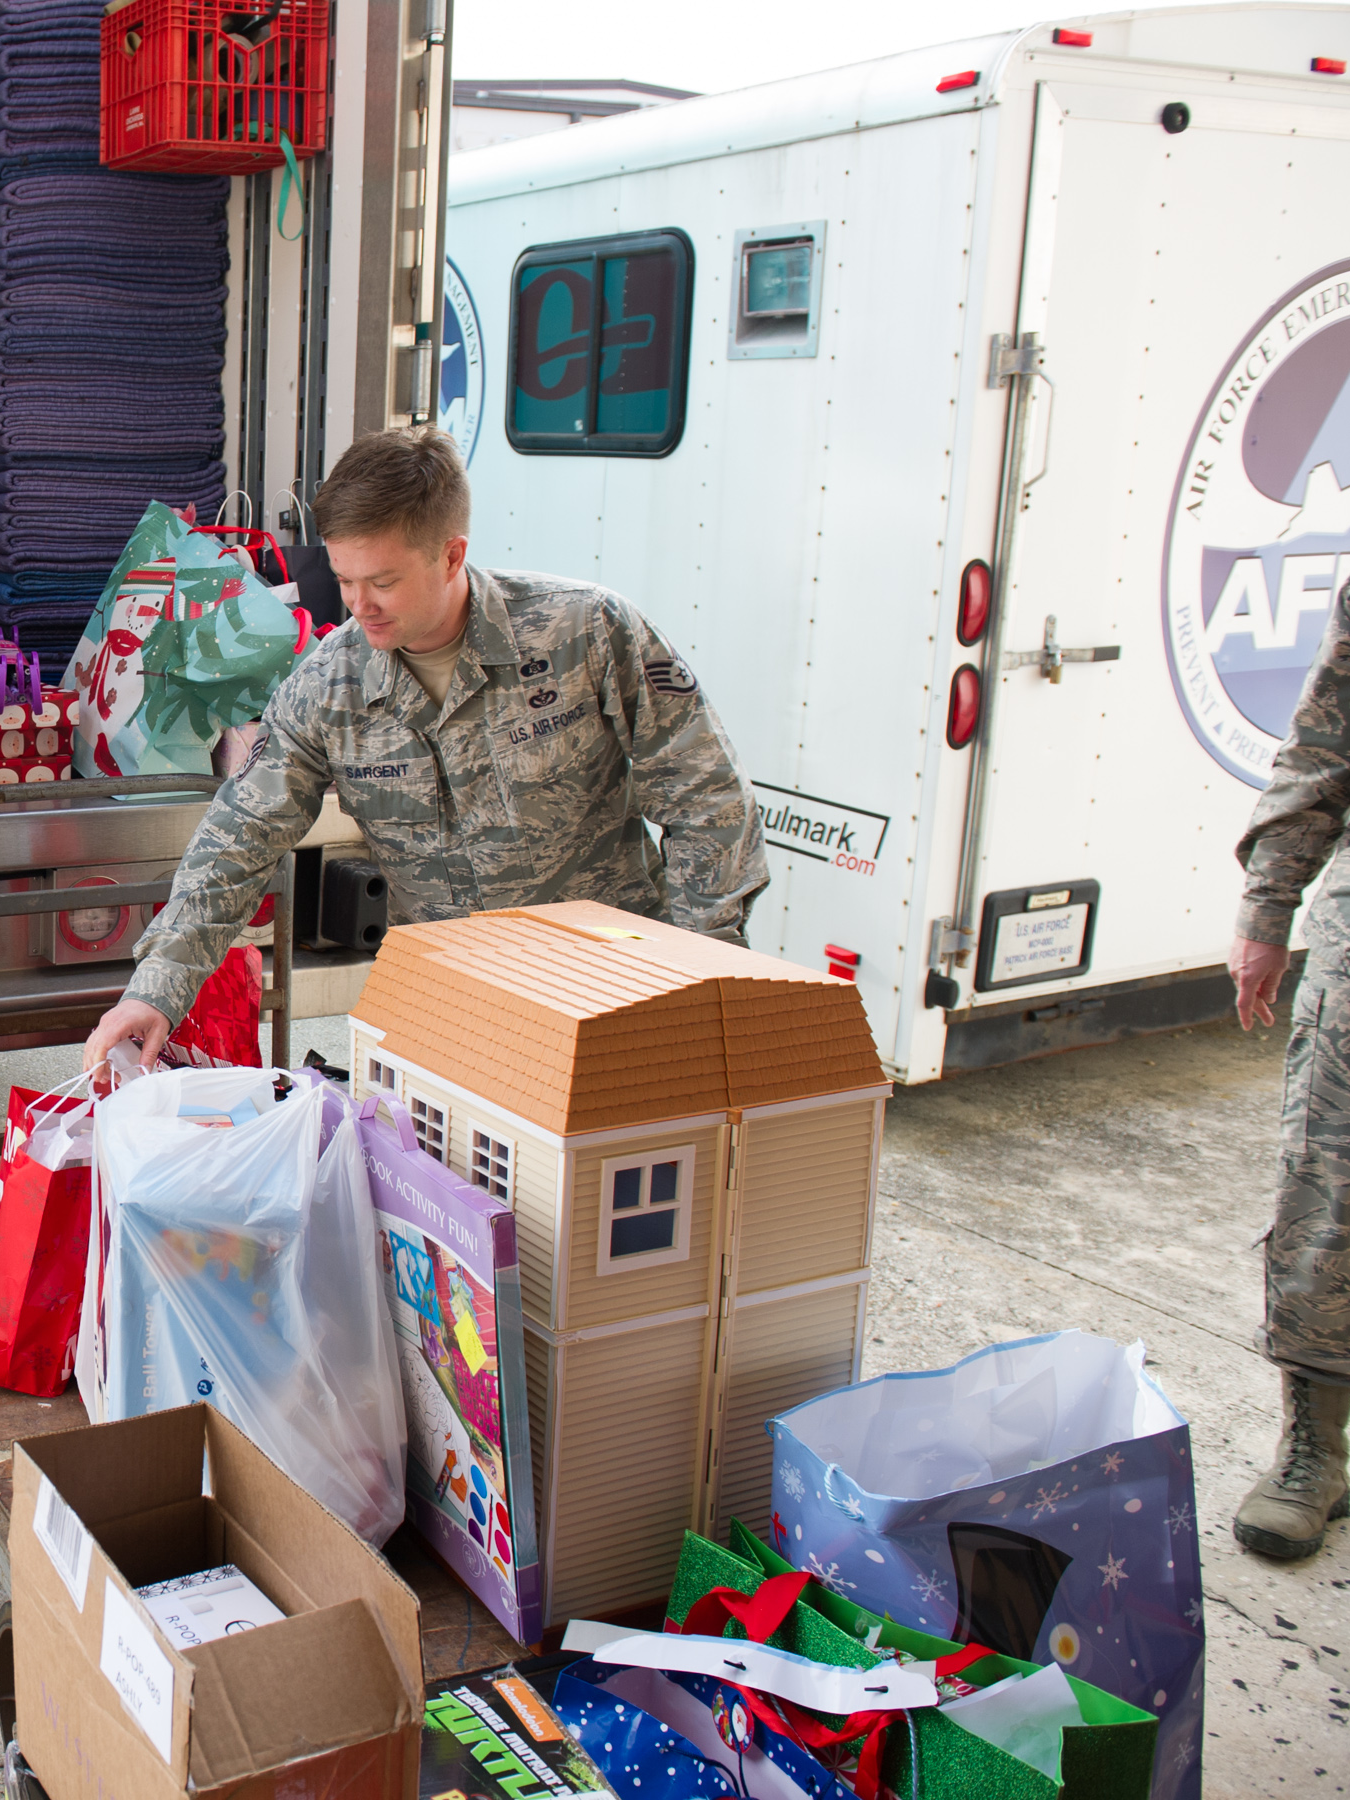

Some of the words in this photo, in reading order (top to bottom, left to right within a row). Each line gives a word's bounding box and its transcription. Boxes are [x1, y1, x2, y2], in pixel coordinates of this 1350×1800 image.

[1186, 459, 1215, 521] AIR
[1207, 337, 1278, 444] FORCE
[1176, 604, 1220, 716] PREVENT
[509, 725, 531, 745] U.S.
[533, 715, 553, 737] AIR
[552, 701, 586, 729] FORCE
[345, 763, 409, 780] SARGENT
[830, 852, 876, 877] .com
[1015, 923, 1029, 937] U.S.
[1031, 922, 1044, 935] AIR
[1045, 917, 1070, 932] FORCE
[395, 1176, 446, 1229] ACTIVITY
[448, 1215, 479, 1256] FUN!
[142, 1303, 158, 1359] Tower
[142, 1363, 158, 1398] Ball
[452, 1685, 511, 1733] TEENAGE
[500, 1732, 564, 1786] MUTANT
[498, 1682, 545, 1738] nickelodeon
